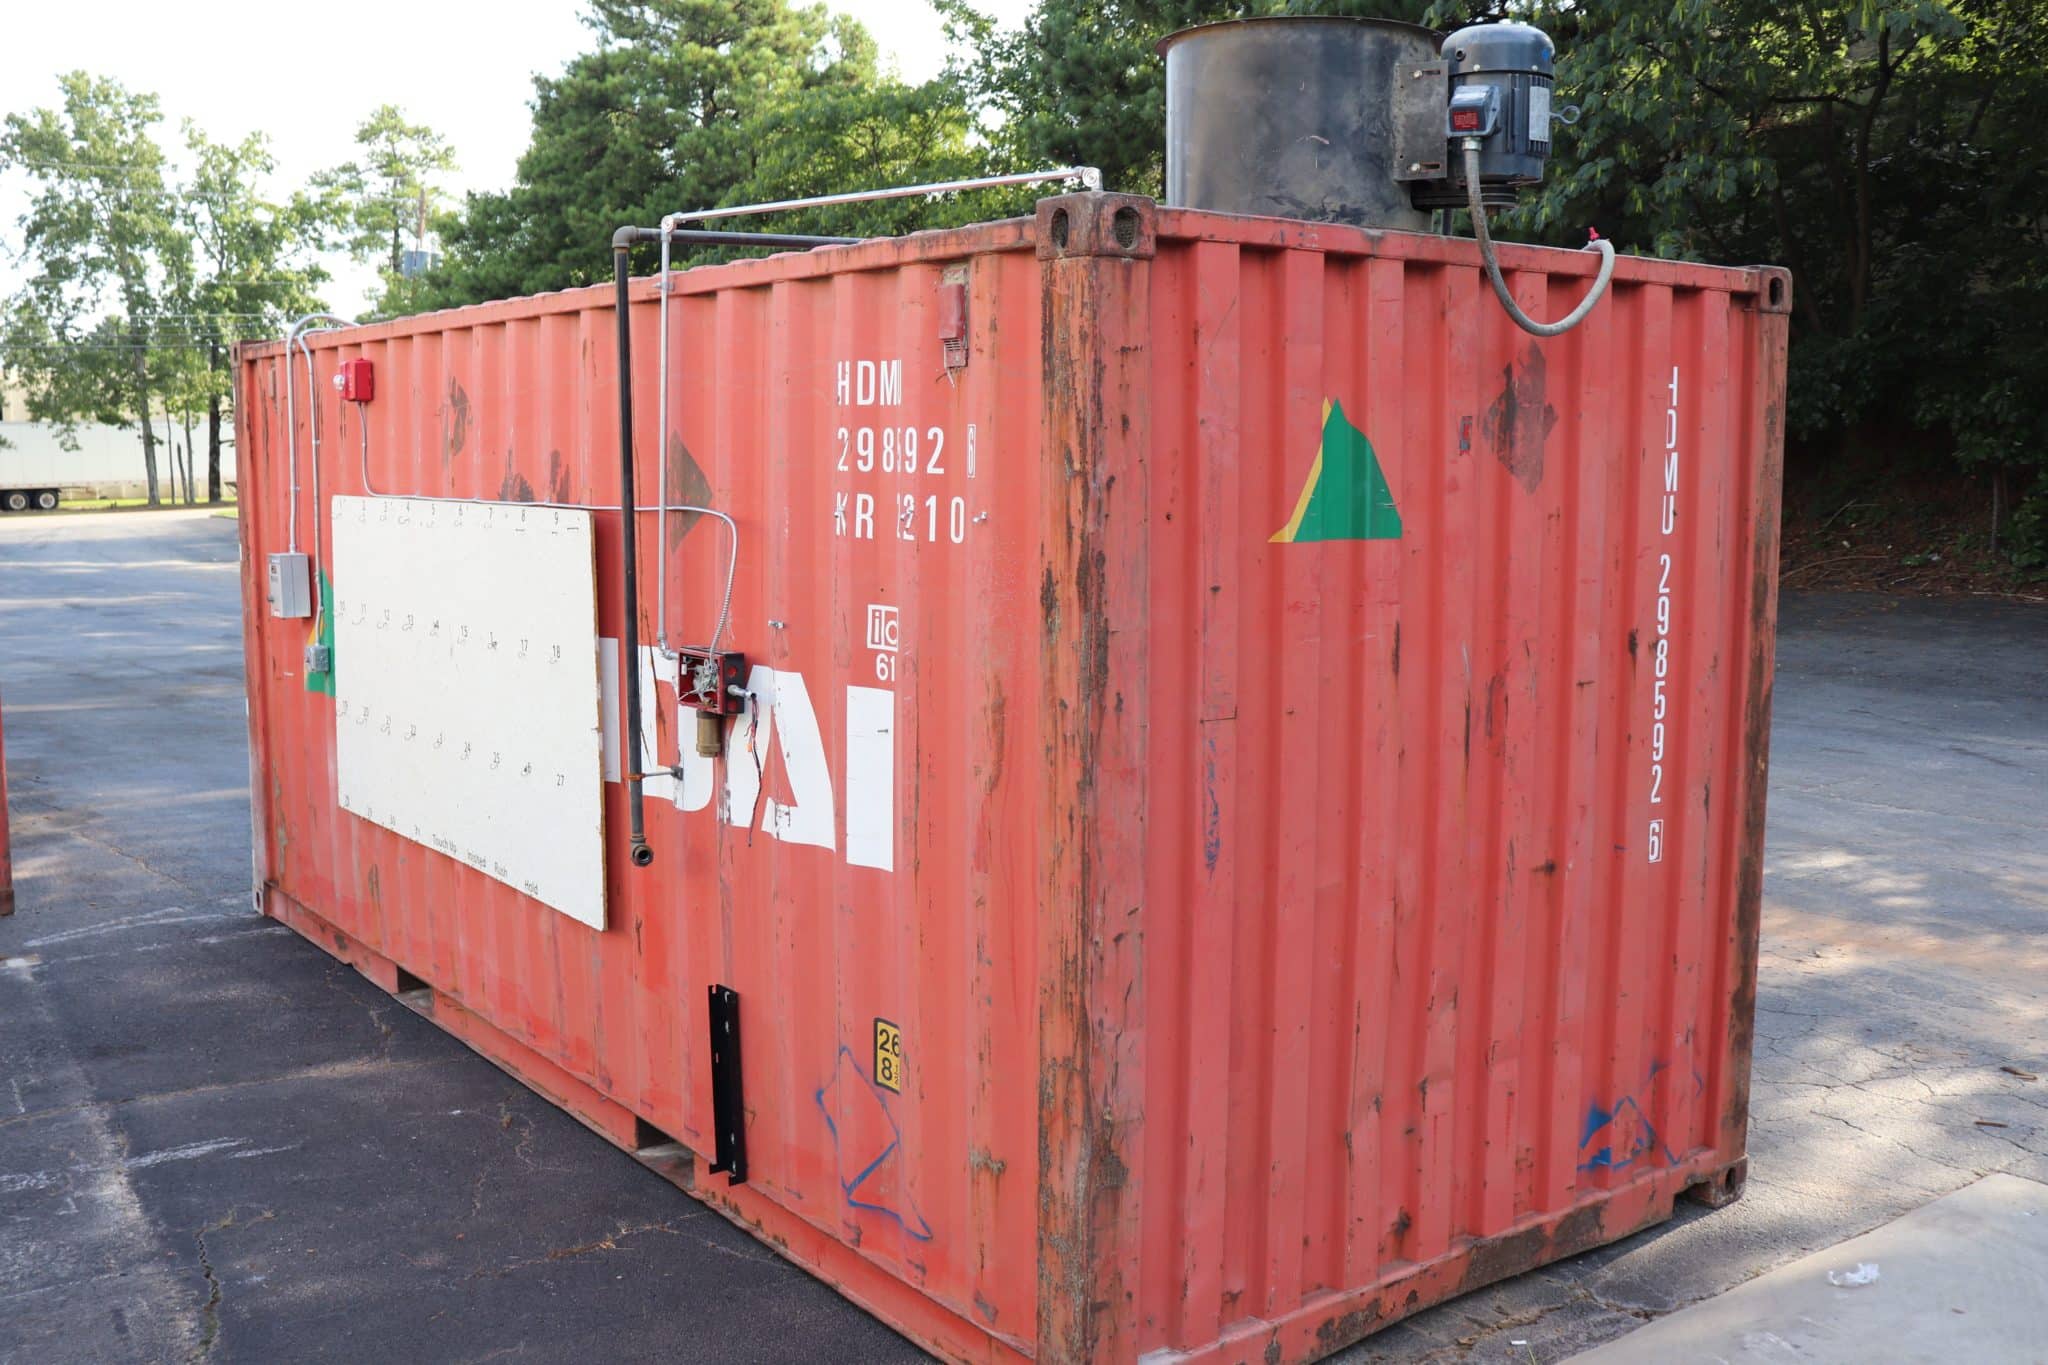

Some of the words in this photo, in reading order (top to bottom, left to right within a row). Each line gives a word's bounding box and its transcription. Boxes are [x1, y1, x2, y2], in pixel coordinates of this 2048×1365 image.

[837, 360, 902, 406] HDM
[837, 427, 945, 474] 29892
[836, 492, 874, 539] KR
[896, 493, 965, 543] 210
[520, 638, 529, 652] 17
[552, 643, 561, 659] 18
[876, 653, 896, 683] 61
[1650, 554, 1671, 803] 298592
[556, 773, 565, 787] 27
[1648, 821, 1662, 862] 6
[881, 1057, 892, 1081] 8
